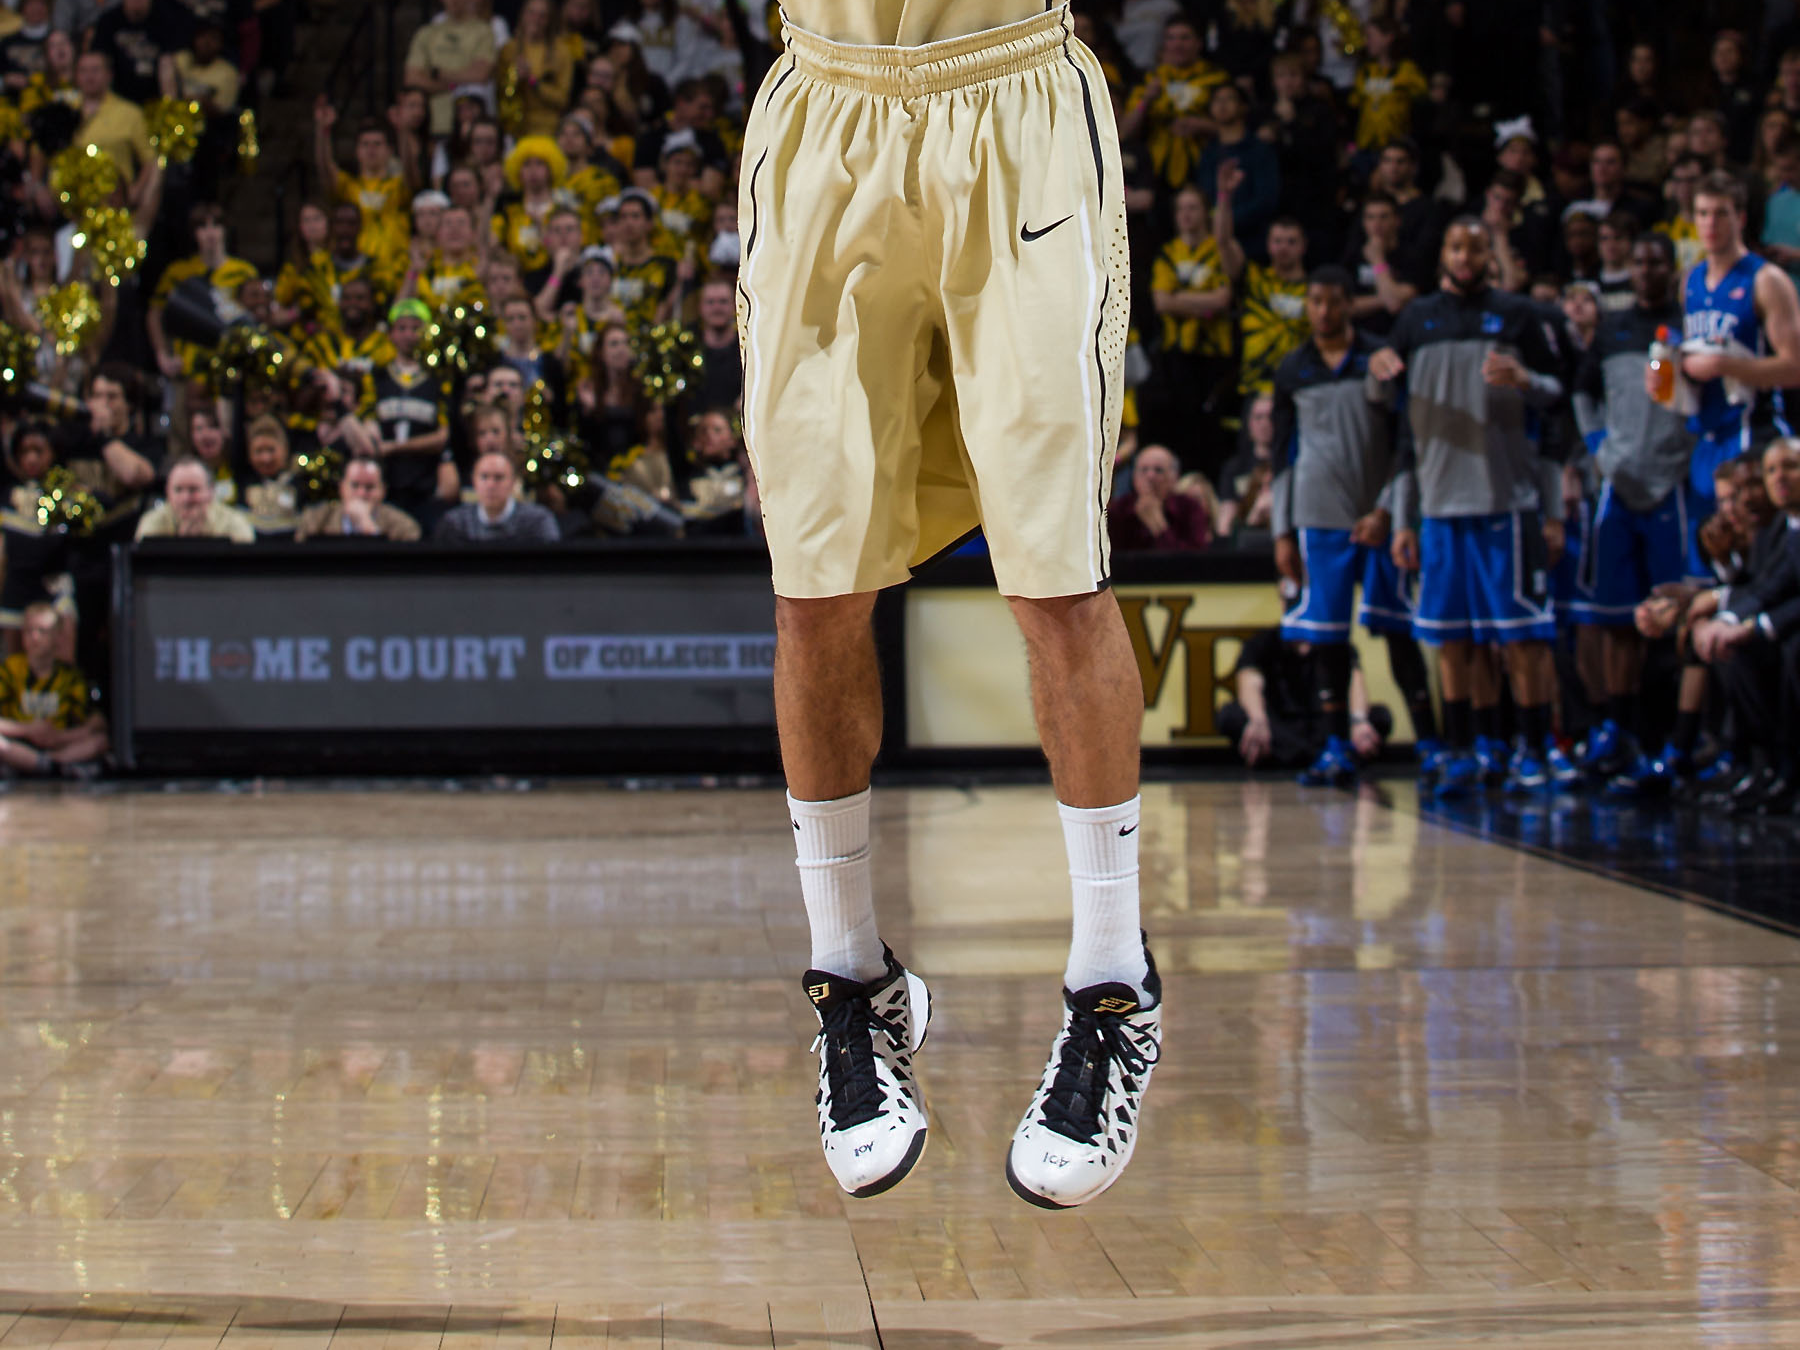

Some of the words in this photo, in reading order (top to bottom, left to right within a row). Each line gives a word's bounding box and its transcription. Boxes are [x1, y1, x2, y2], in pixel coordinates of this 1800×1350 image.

[346, 635, 526, 682] COURT
[554, 643, 590, 669] OF
[600, 643, 730, 669] COLLEGE
